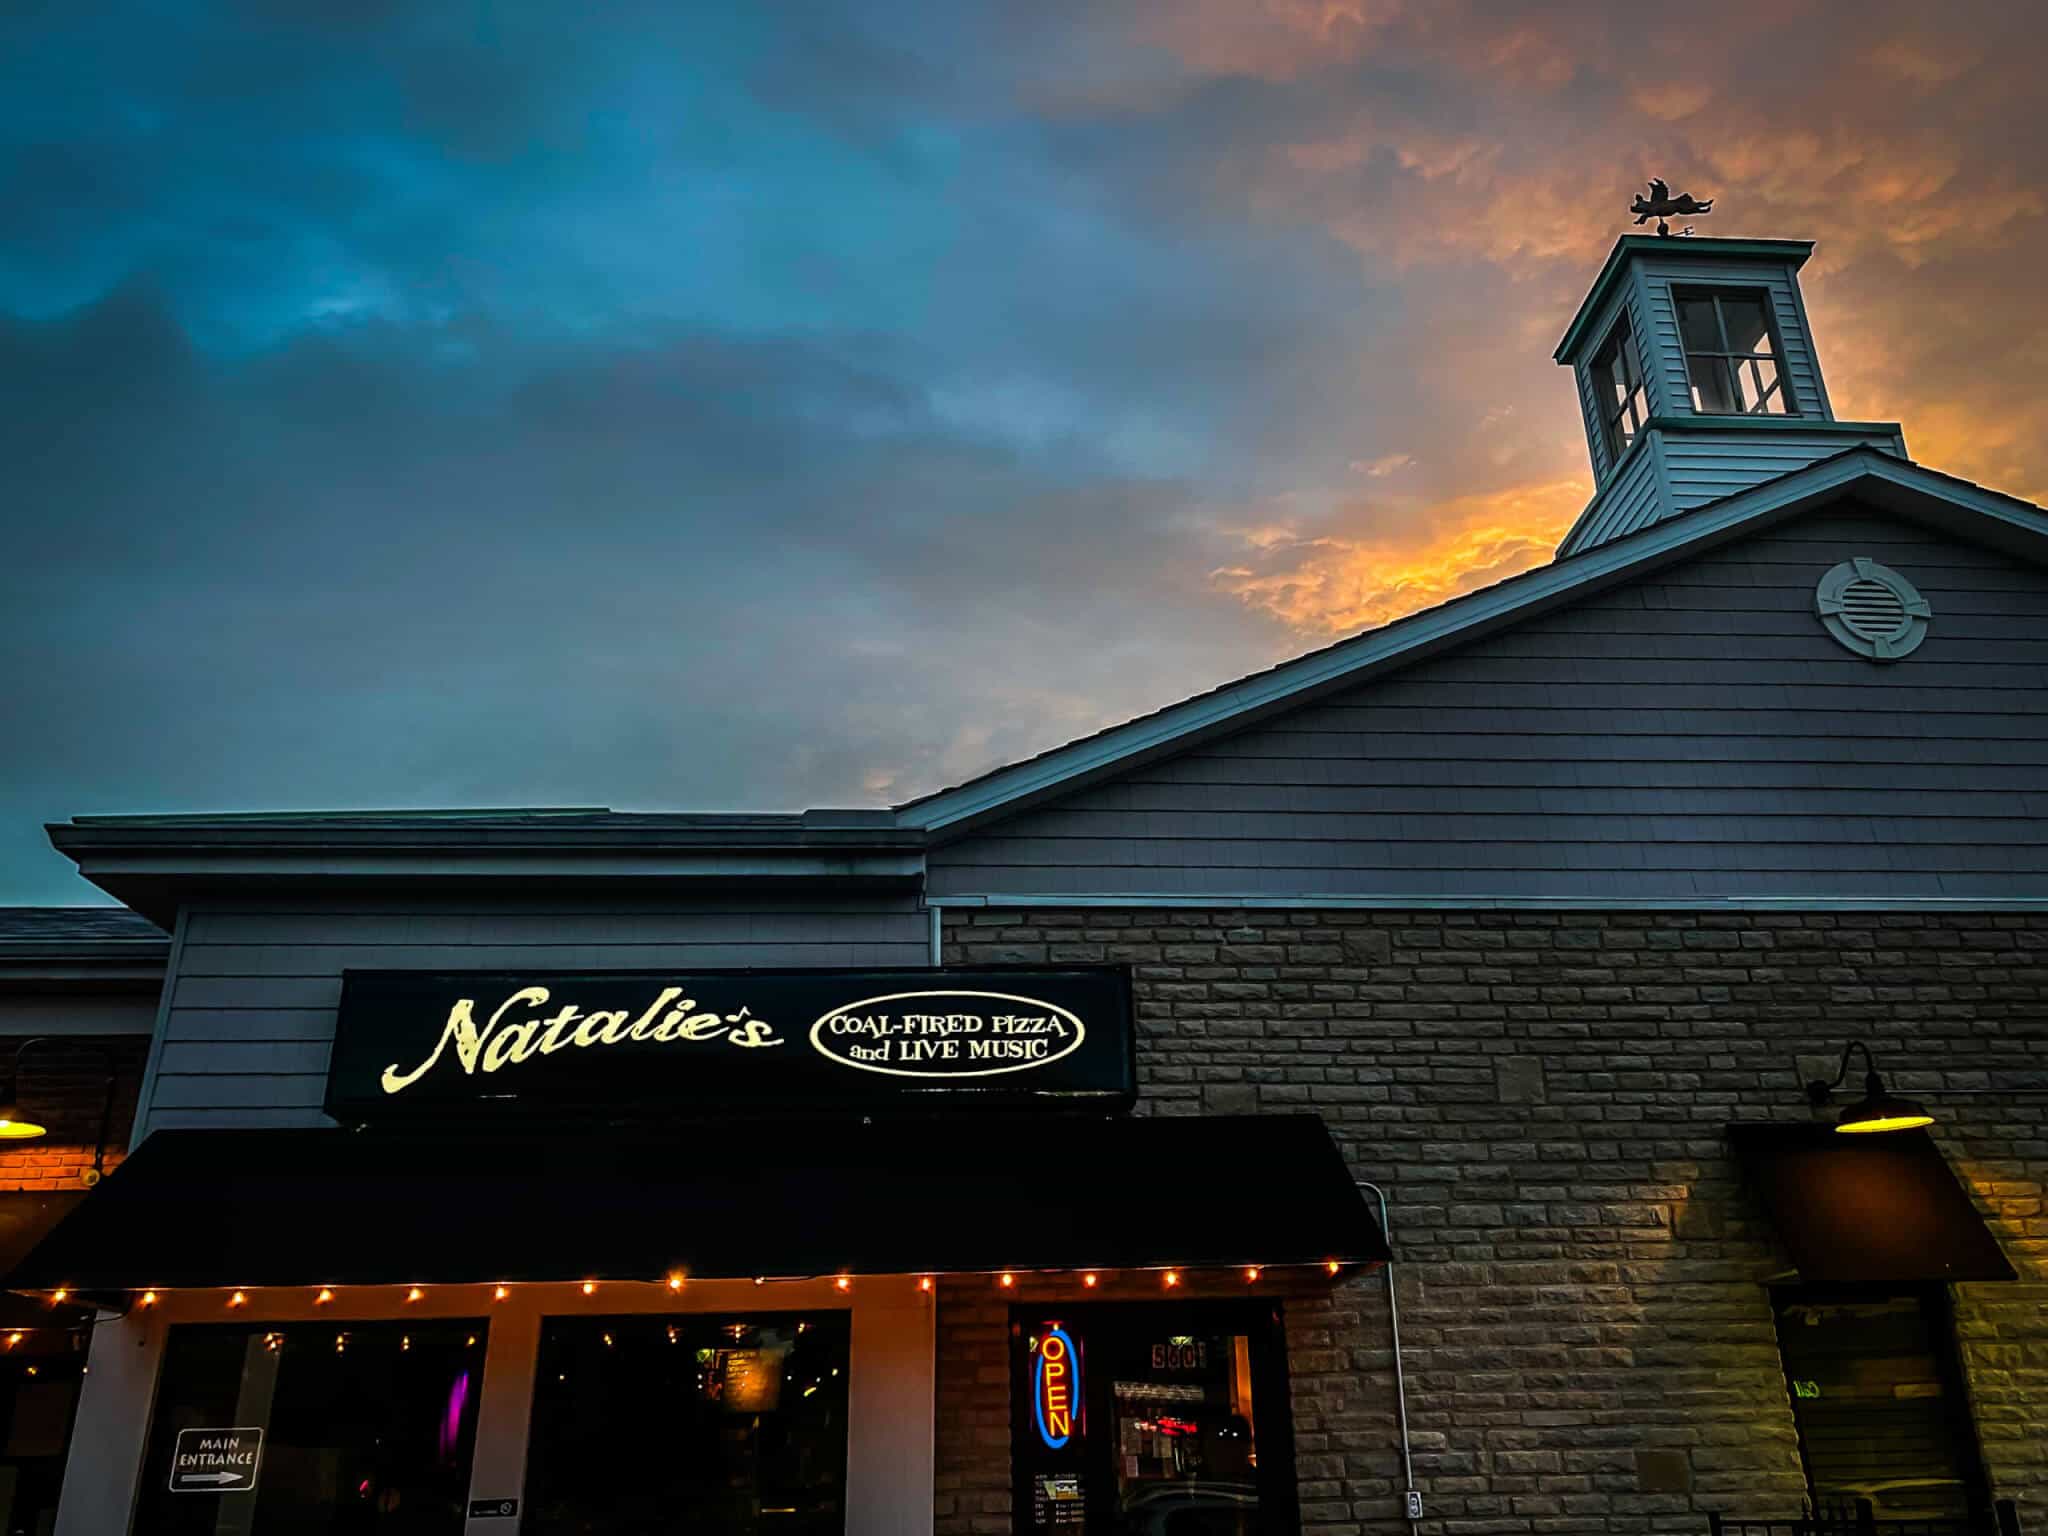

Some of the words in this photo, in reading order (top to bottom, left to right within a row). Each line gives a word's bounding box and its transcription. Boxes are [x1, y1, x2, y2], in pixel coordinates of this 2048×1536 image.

[829, 1014, 983, 1039] COAL-FIRED
[991, 1014, 1069, 1037] PIZZA
[381, 986, 785, 1094] Natalie's
[849, 1040, 890, 1061] and
[899, 1039, 960, 1061] LIVE
[968, 1038, 1049, 1060] MUSIC
[1042, 1336, 1071, 1437] OPEN
[199, 1437, 240, 1450] MAIN
[180, 1451, 254, 1466] ENTRANCE
